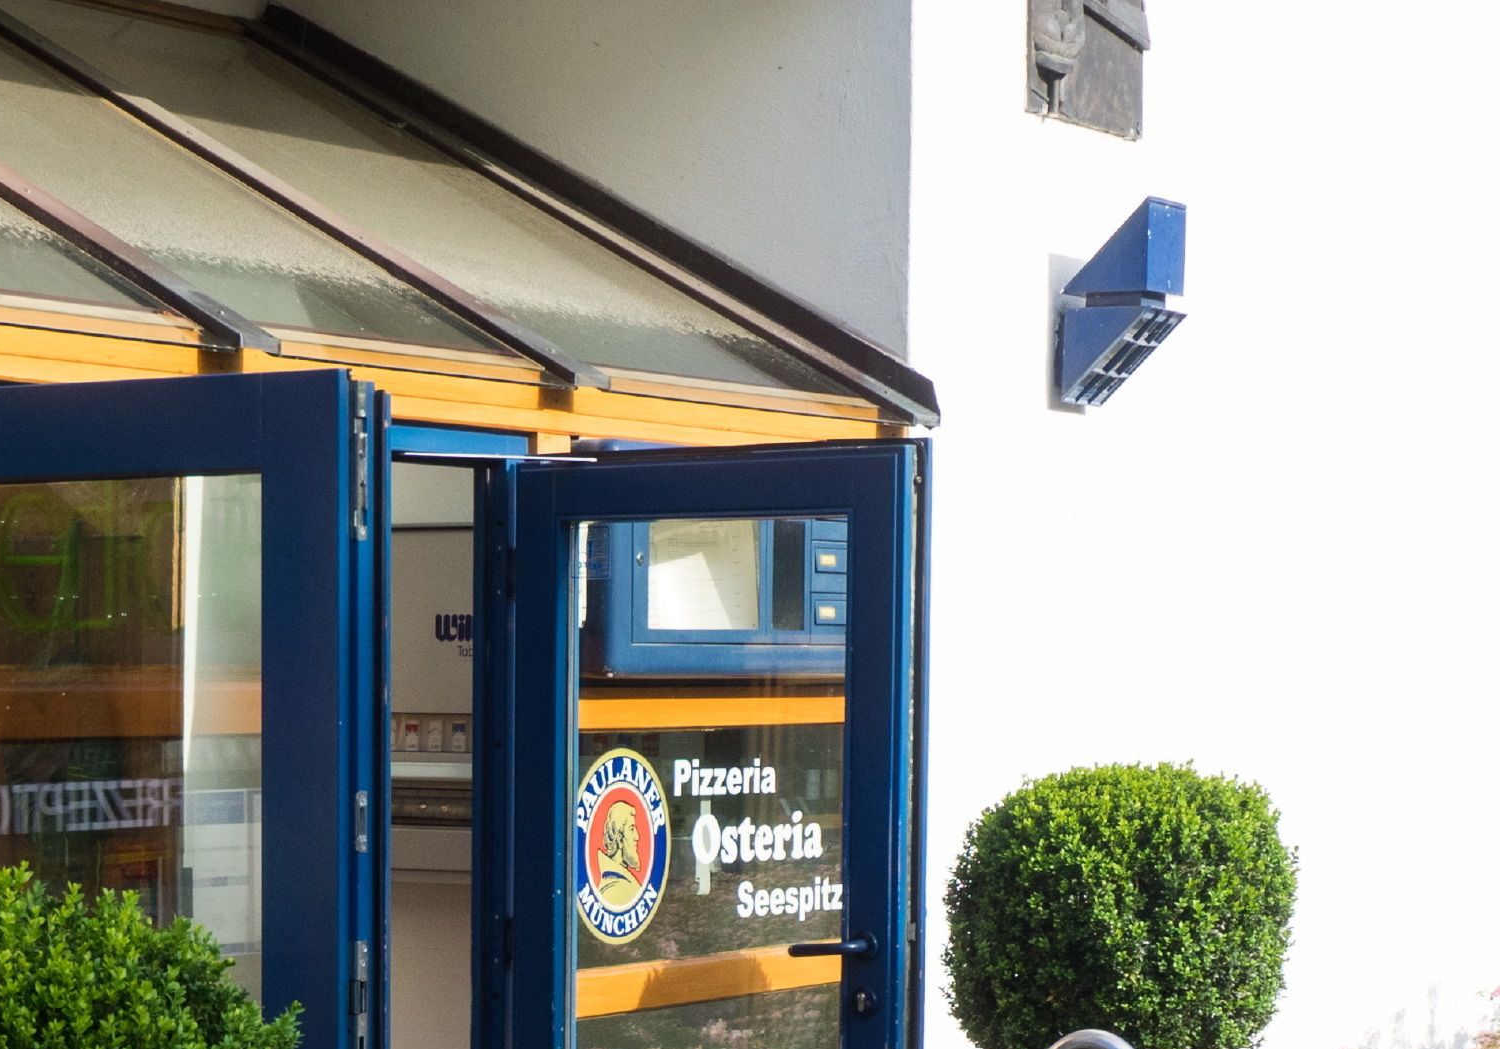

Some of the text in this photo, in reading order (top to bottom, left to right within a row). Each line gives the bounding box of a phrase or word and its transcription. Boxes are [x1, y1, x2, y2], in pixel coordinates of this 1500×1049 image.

[577, 756, 666, 836] PAULANER
[673, 758, 776, 797] Pizzeria
[692, 811, 823, 865] Osteria
[578, 883, 658, 936] MÜNCHEN
[736, 876, 843, 921] Seespitz
